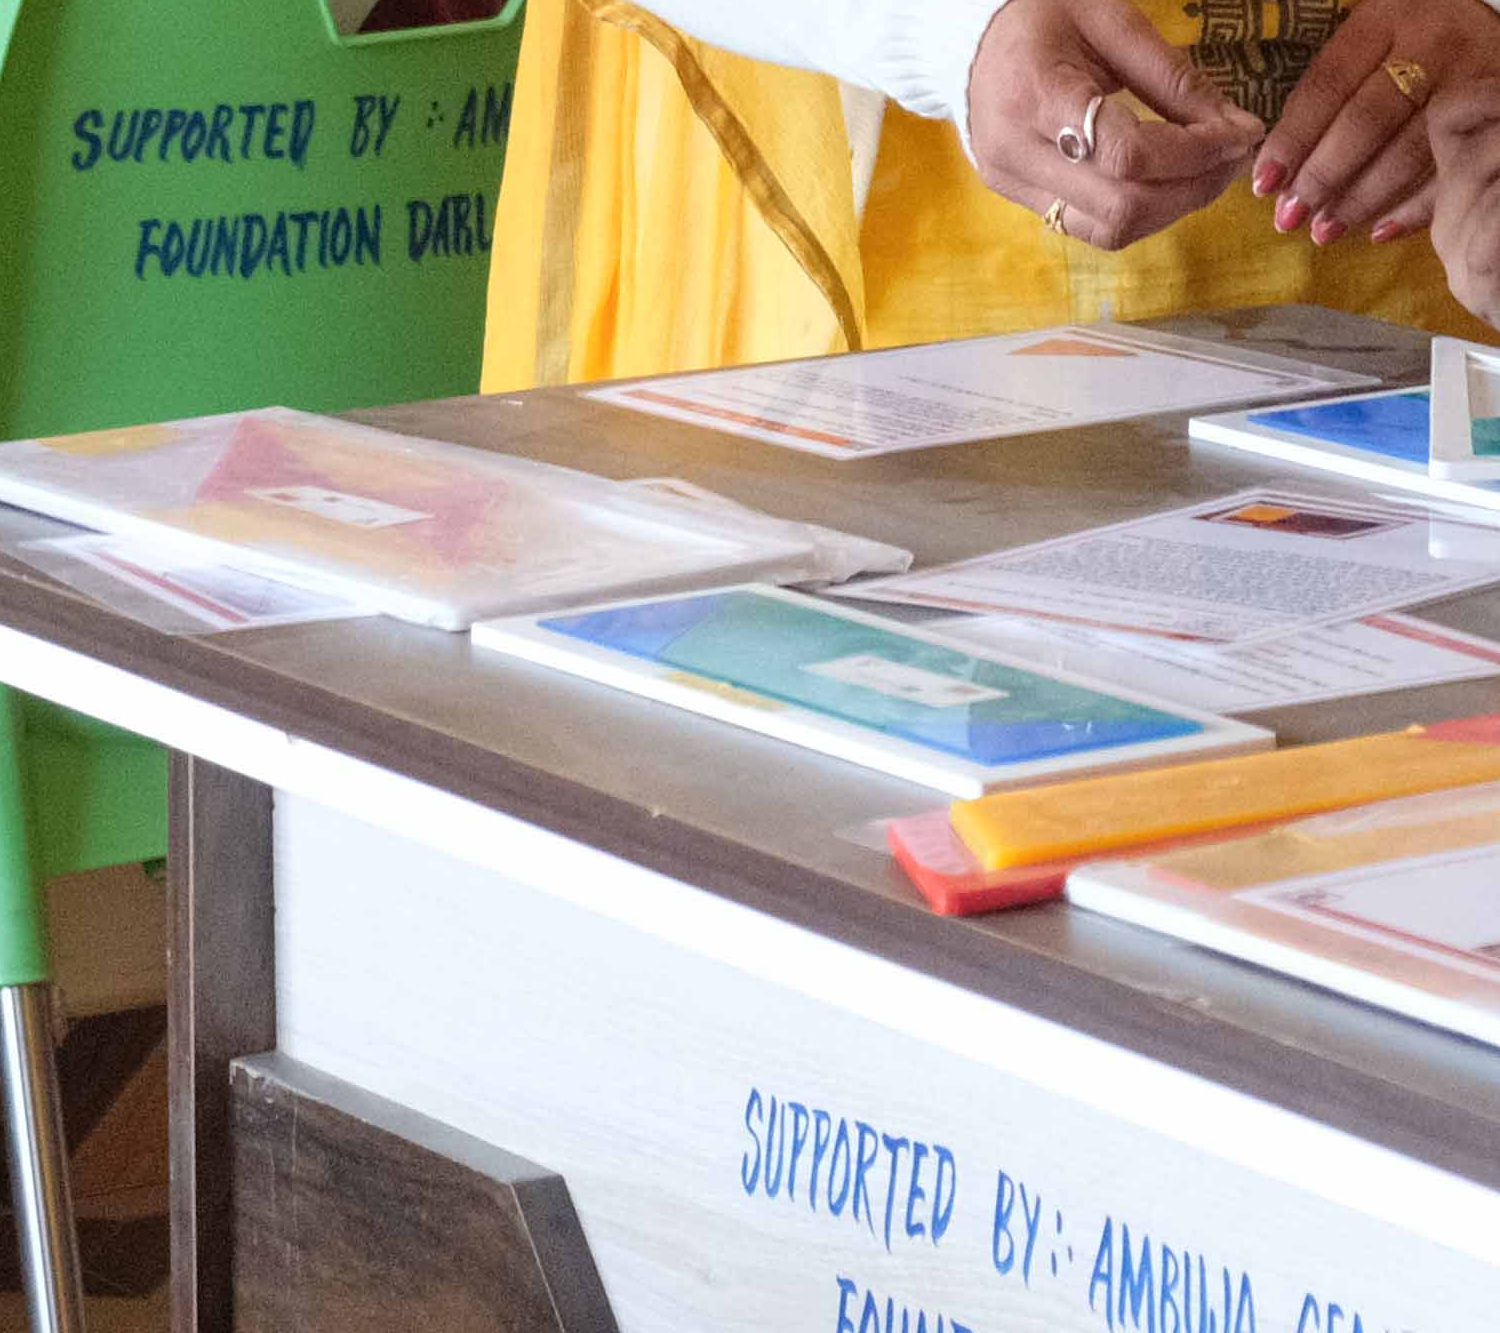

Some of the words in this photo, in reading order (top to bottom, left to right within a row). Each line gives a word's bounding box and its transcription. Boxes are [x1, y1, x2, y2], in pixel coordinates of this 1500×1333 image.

[72, 100, 315, 172] SUPPORTED
[350, 93, 400, 158] BY
[135, 205, 381, 280] FOUNDATION
[741, 1086, 957, 1253] SUPPORTED
